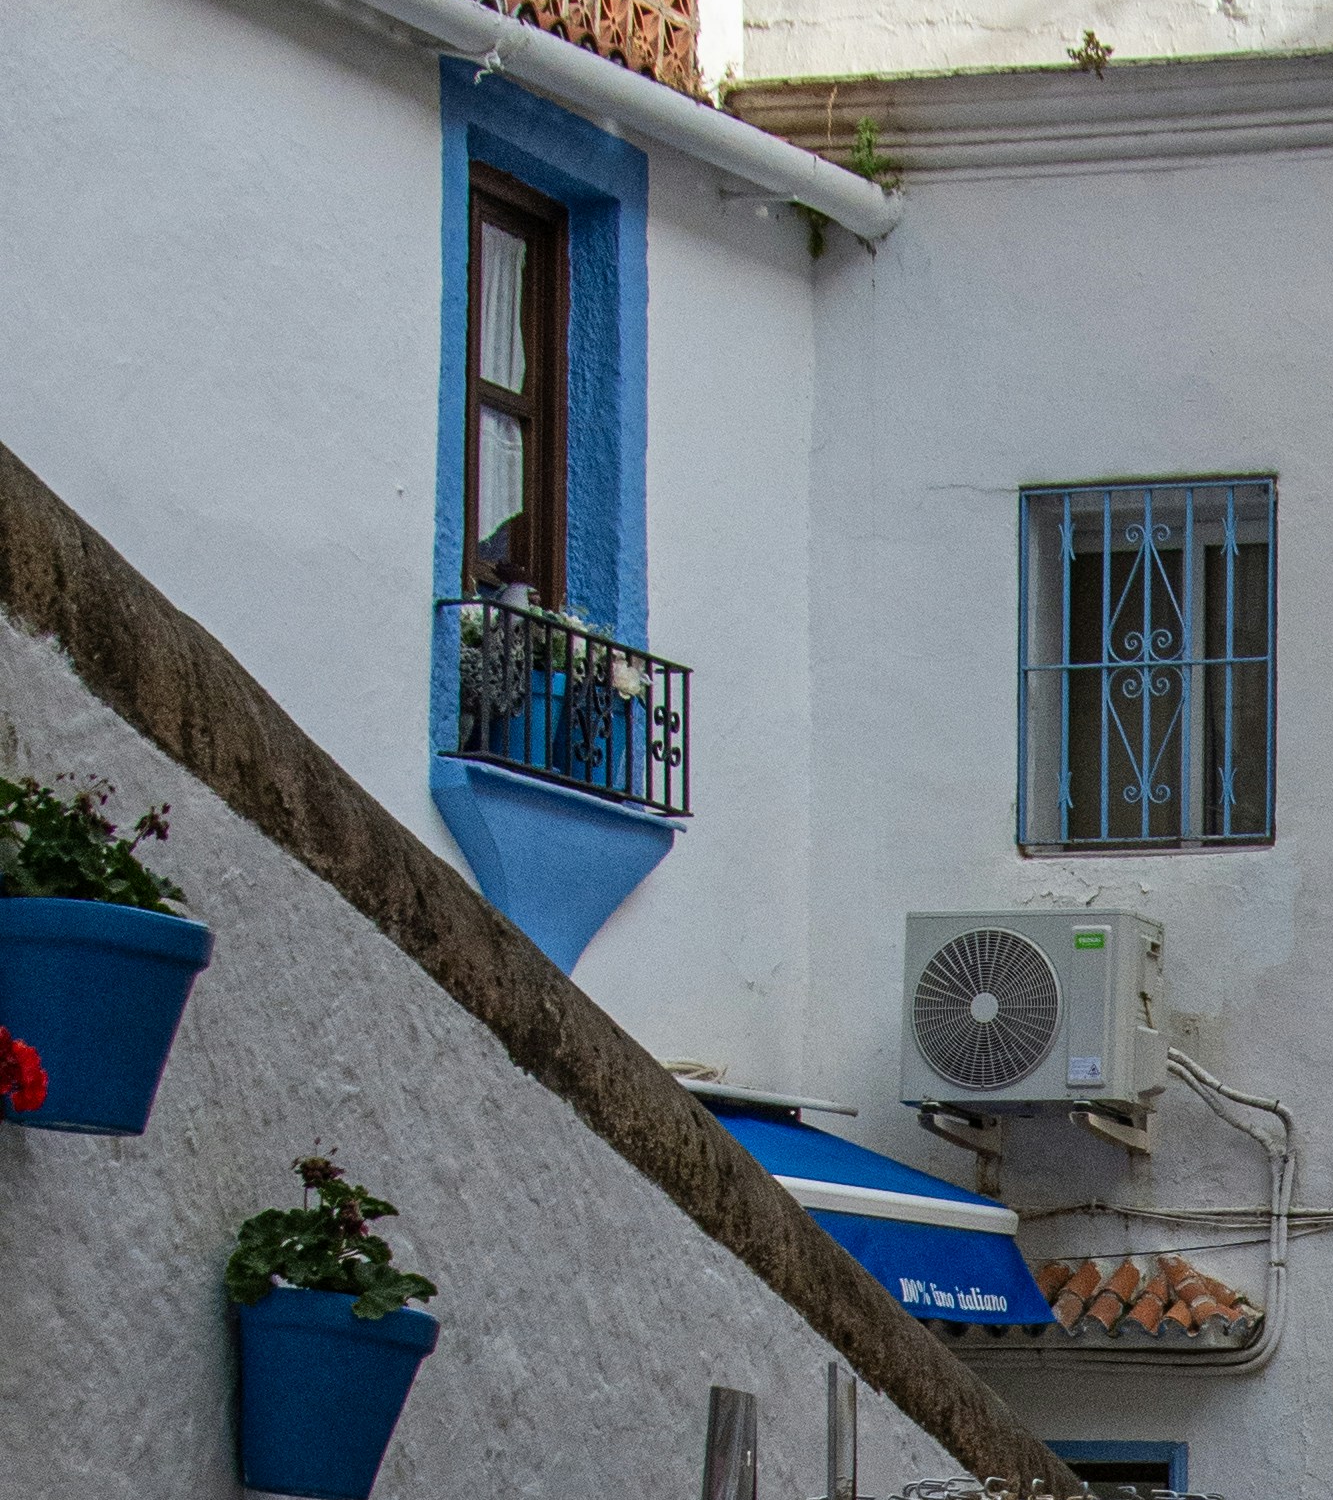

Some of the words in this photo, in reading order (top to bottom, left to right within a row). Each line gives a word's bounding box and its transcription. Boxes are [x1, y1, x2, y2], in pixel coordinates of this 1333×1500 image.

[900, 1277, 931, 1305] 100%
[930, 1282, 955, 1309] lino
[955, 1285, 1008, 1312] italiano
